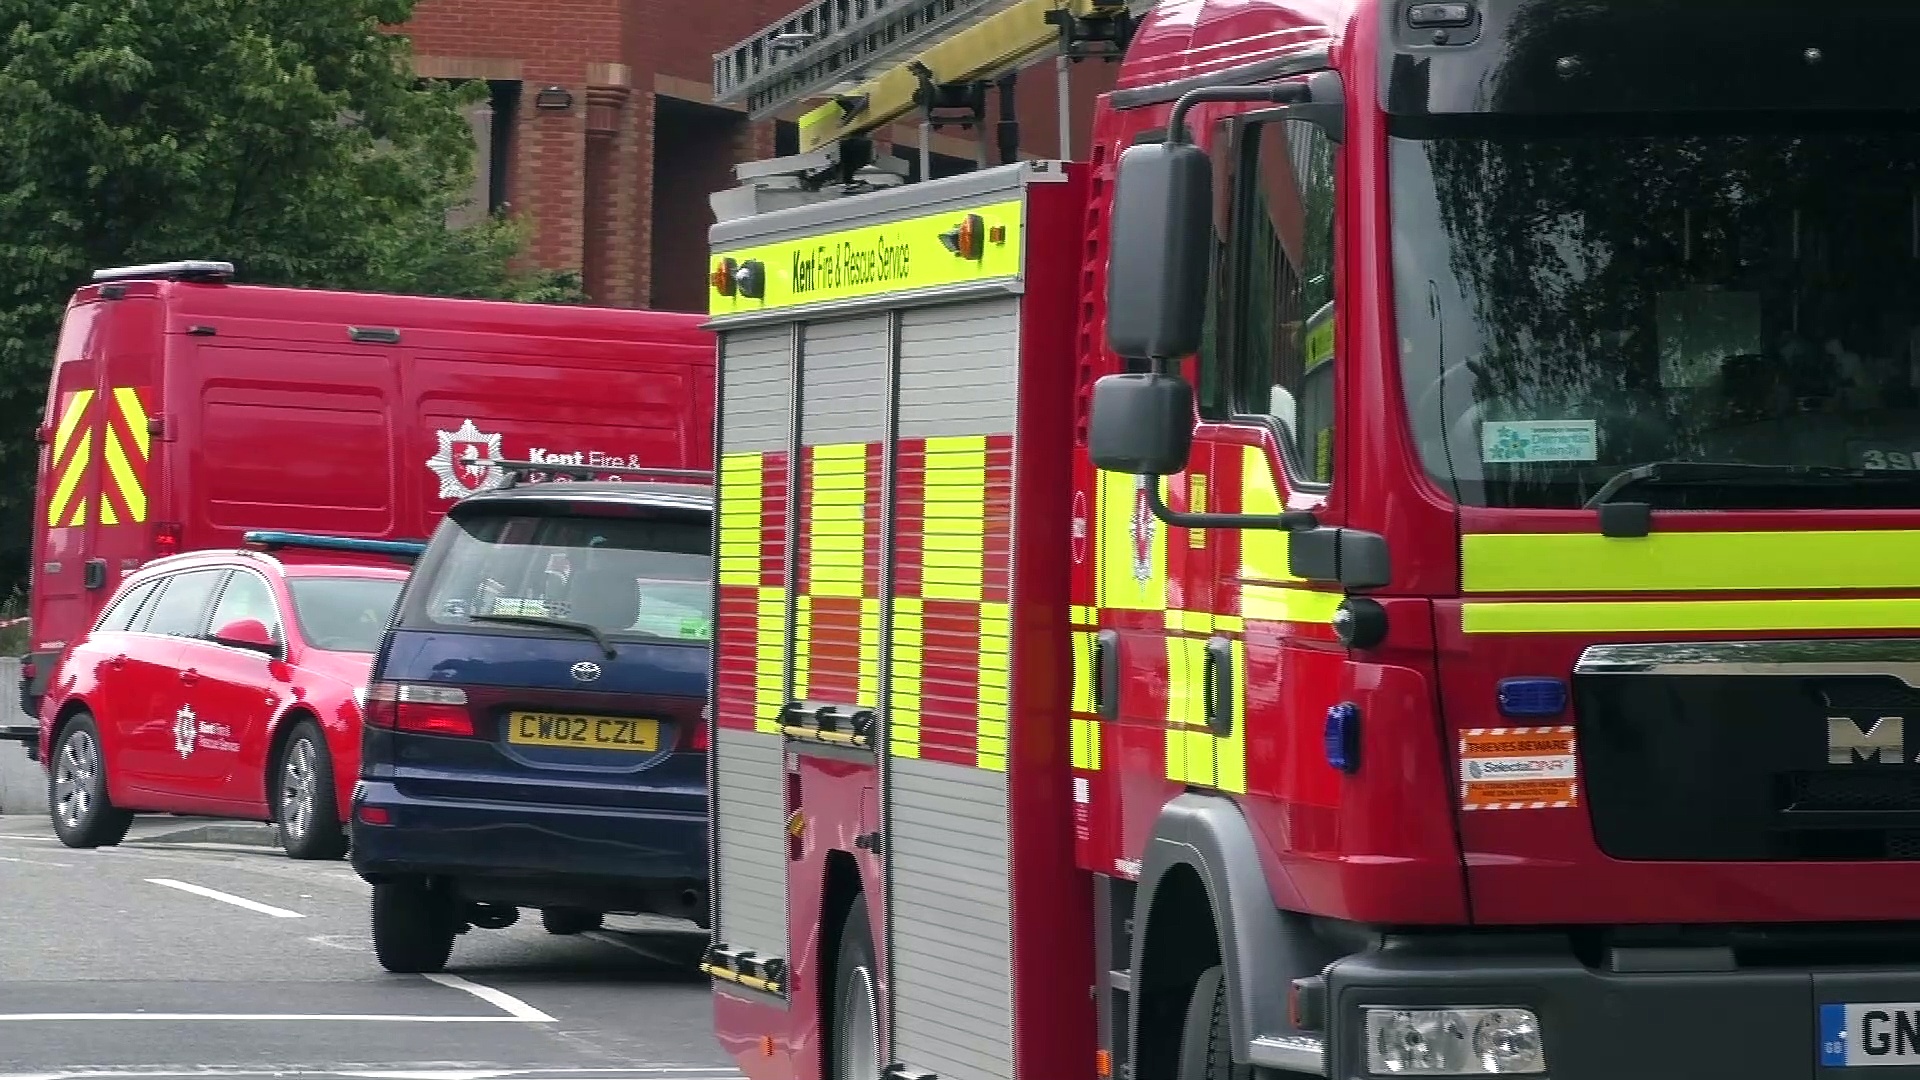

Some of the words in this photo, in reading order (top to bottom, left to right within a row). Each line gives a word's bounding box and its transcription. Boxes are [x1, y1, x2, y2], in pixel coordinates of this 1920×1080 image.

[792, 249, 815, 294] Kent
[817, 246, 833, 288] Fire
[834, 243, 842, 288] &
[843, 241, 875, 287] Rescue
[878, 233, 910, 281] Service
[528, 447, 584, 466] Kent
[588, 450, 625, 468] Fire
[628, 454, 641, 469] &
[519, 715, 589, 742] CW02
[595, 719, 646, 745] CZL
[1827, 716, 1920, 764] M
[1467, 741, 1517, 753] THIEVES
[1518, 739, 1570, 752] BEWARE
